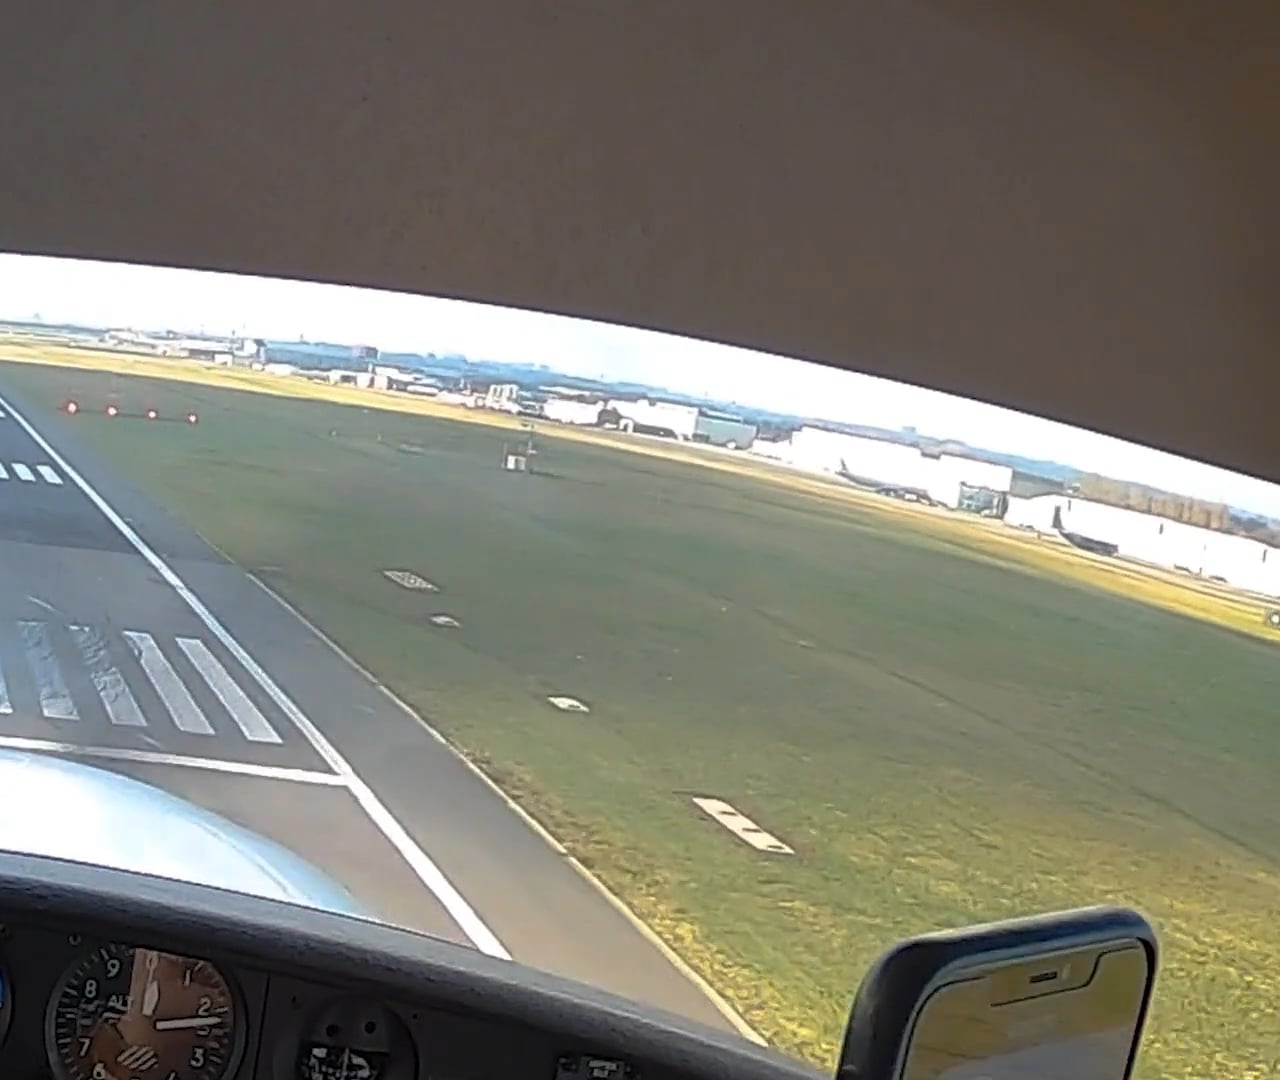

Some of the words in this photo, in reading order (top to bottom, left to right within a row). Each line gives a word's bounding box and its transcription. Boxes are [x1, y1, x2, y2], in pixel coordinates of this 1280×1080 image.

[107, 959, 121, 979] 9
[84, 980, 98, 998] 8
[198, 996, 212, 1016] 2
[78, 1037, 91, 1057] 7
[190, 1047, 205, 1068] 3
[92, 1062, 107, 1080] 6
